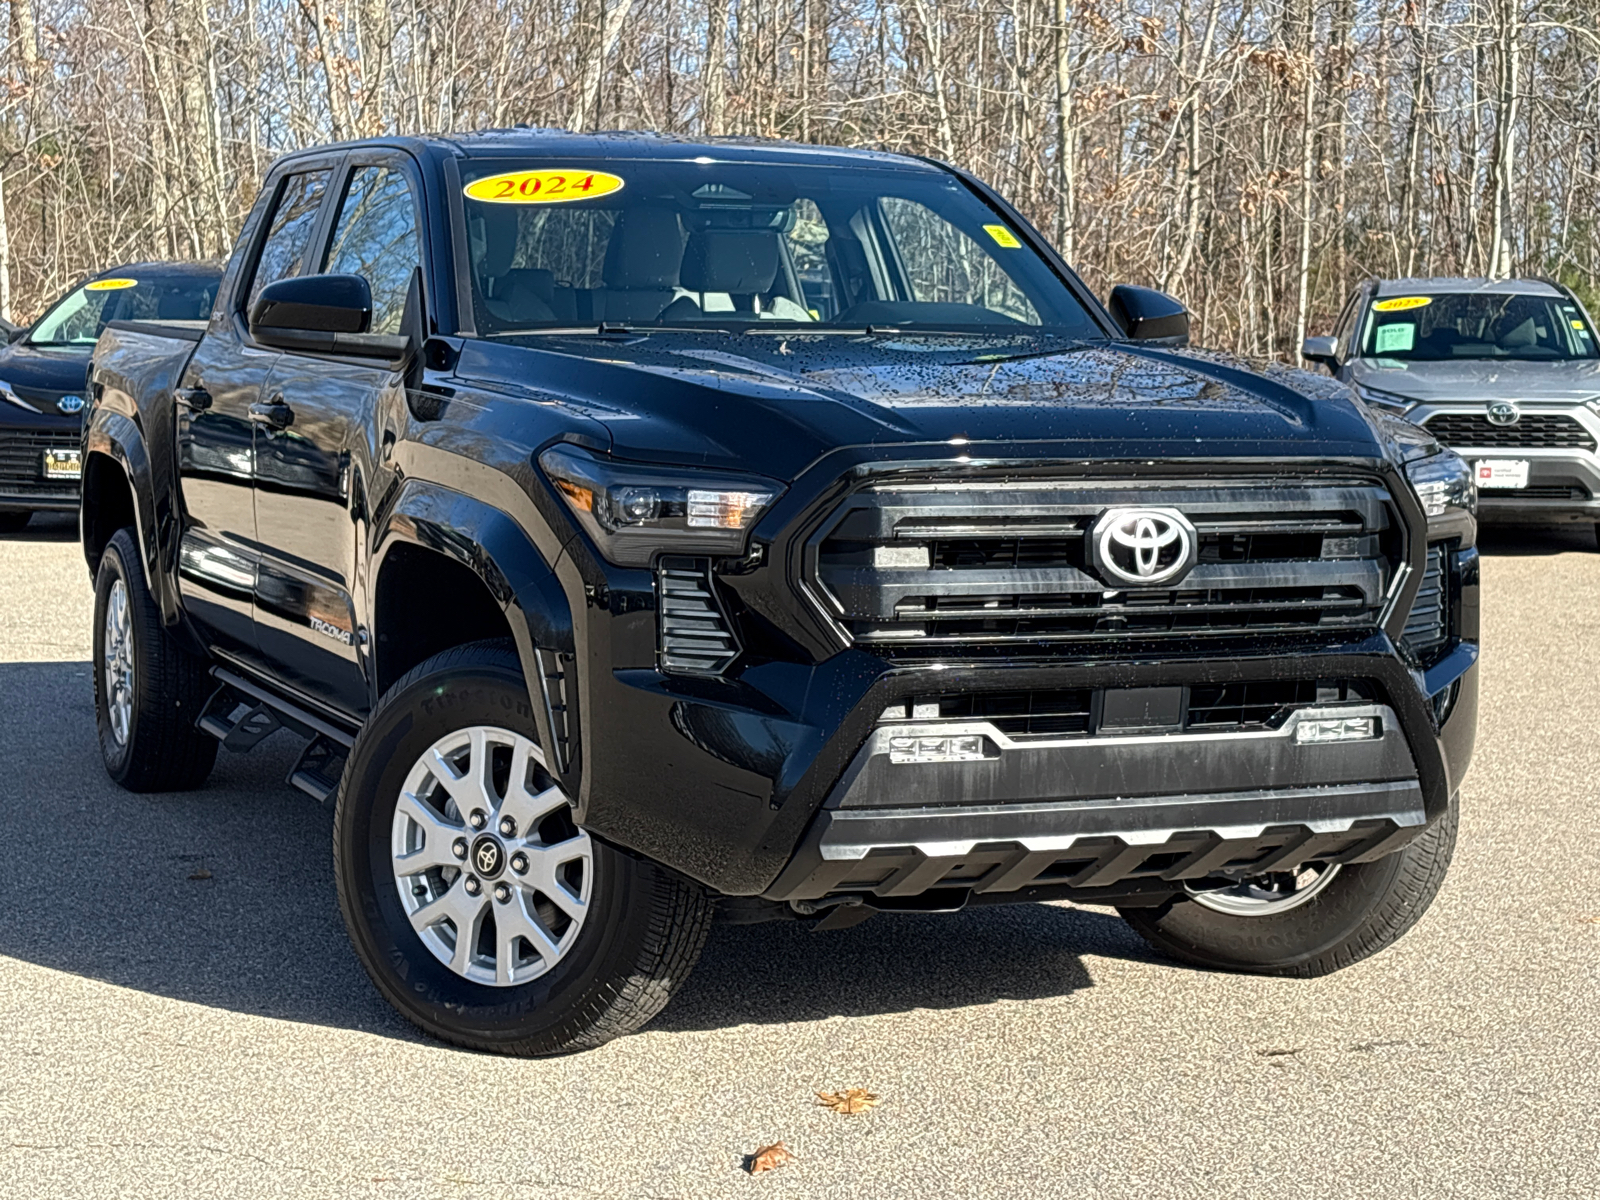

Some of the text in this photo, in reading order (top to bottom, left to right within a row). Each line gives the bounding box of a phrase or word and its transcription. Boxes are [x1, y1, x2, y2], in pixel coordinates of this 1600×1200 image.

[493, 174, 595, 199] 2024
[310, 615, 351, 646] TACOMA
[420, 688, 530, 719] Fireston
